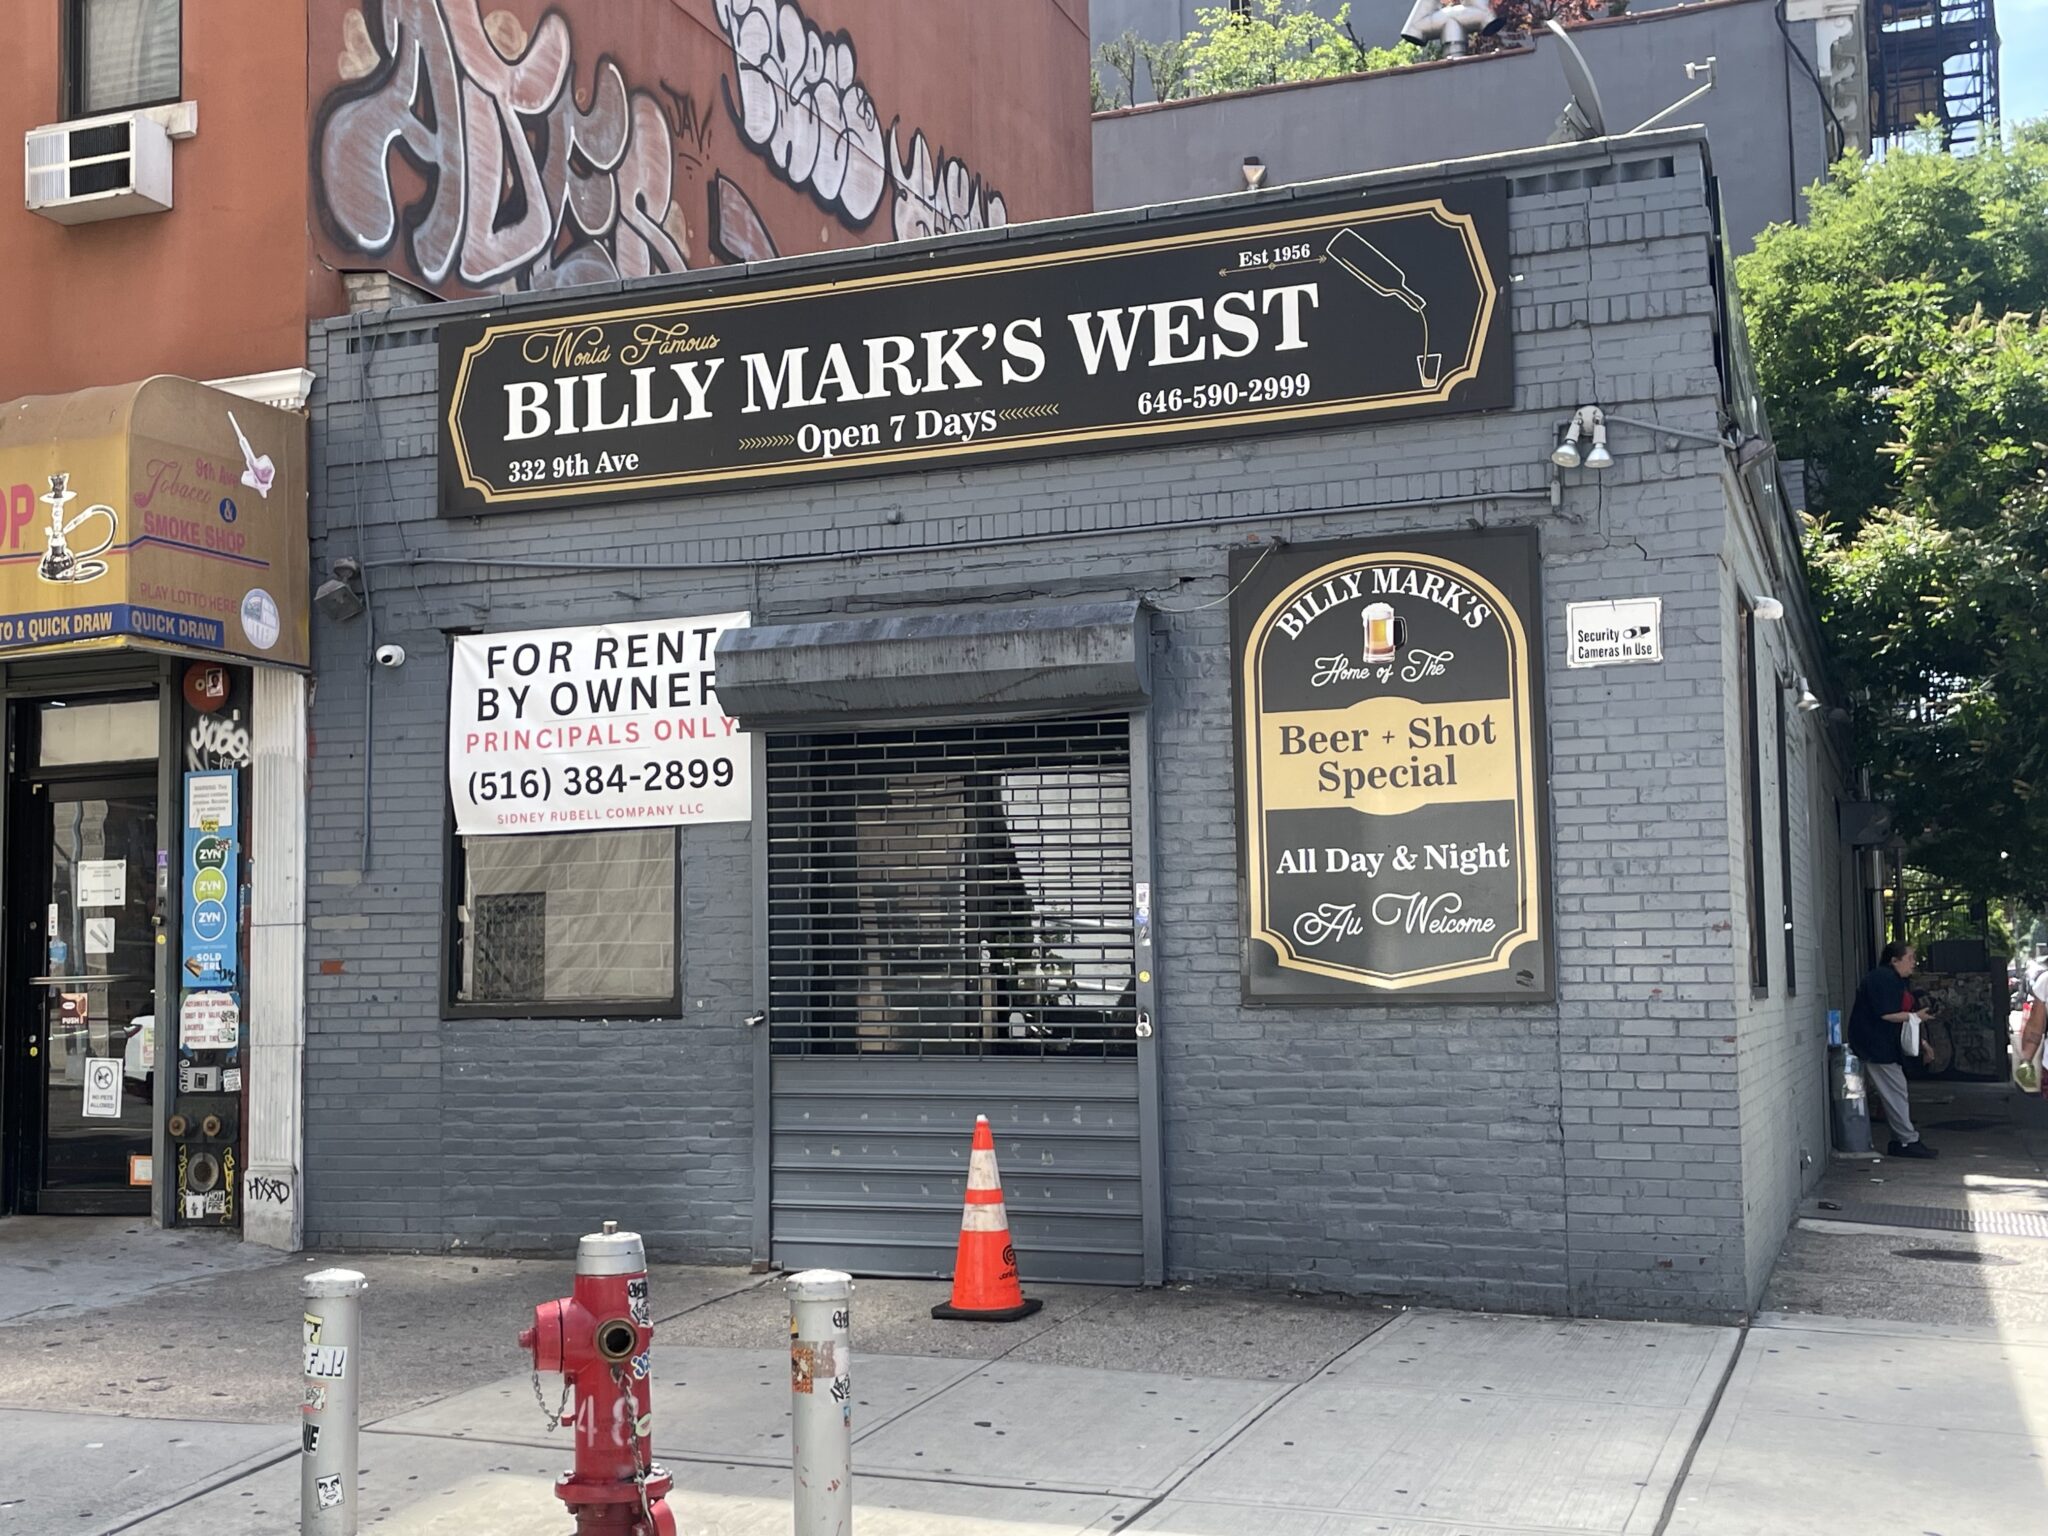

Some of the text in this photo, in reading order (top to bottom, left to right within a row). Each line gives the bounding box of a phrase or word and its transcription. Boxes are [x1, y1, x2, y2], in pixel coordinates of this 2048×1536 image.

[1238, 243, 1311, 268] Est 1956
[503, 283, 1319, 441] BILLY MARK'S WEST
[522, 323, 721, 369] World Famous
[1137, 373, 1311, 415] 646-590-2999
[797, 408, 998, 458] Open 7 Days
[508, 450, 639, 483] 332 9th Ave
[144, 510, 246, 553] SMOKE SHOP
[140, 582, 237, 614] PLAY LOTTO HERE
[1275, 568, 1491, 641] BILLY MARK'S
[17, 620, 25, 639] &
[28, 616, 70, 642] QUICK
[74, 612, 113, 634] DRAW
[131, 610, 175, 635] QUICK
[179, 619, 217, 642] DRAW
[1577, 628, 1620, 643] Security
[487, 627, 717, 679] FOR RENT
[1311, 649, 1454, 687] Home of The
[1578, 643, 1652, 659] Cameras In Use
[477, 670, 717, 722] BY OWNER
[466, 716, 736, 754] PRINCIPALS ONLY
[1279, 725, 1369, 756] Beer
[1408, 714, 1497, 749] Shot
[468, 757, 734, 805] (516) 384-2899
[1318, 754, 1457, 799] Special
[497, 803, 705, 825] SIDNEY RUBELL COMPANY LLC
[199, 849, 221, 860] ZYN
[1276, 842, 1510, 879] All Day & Night
[199, 880, 221, 891] ZYN
[198, 912, 220, 923] ZYN
[1293, 891, 1496, 946] All Welcome
[196, 953, 222, 962] SOLD
